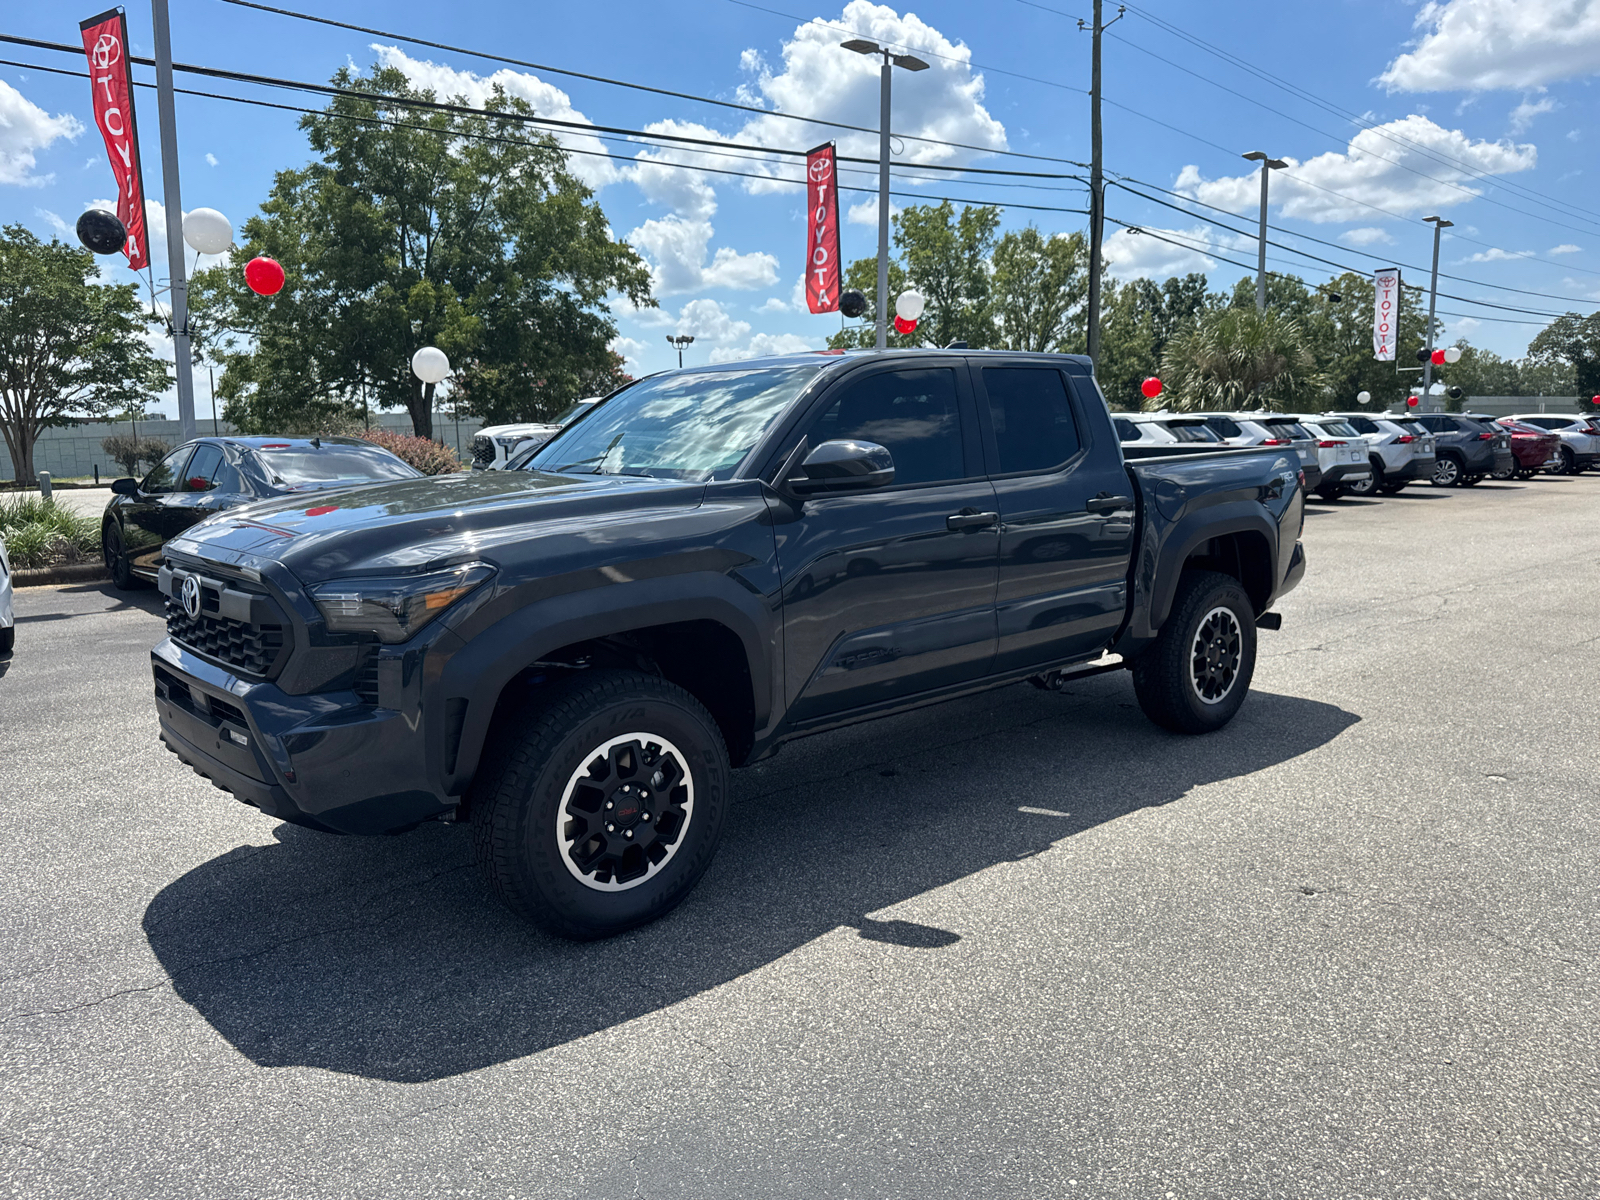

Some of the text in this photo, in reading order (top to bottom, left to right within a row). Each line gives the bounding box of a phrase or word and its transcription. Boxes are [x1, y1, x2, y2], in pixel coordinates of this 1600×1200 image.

[813, 185, 831, 306] TOYOTA
[1379, 290, 1391, 354] TOYOTA
[1279, 471, 1294, 482] TRD
[833, 646, 901, 665] TACOMA
